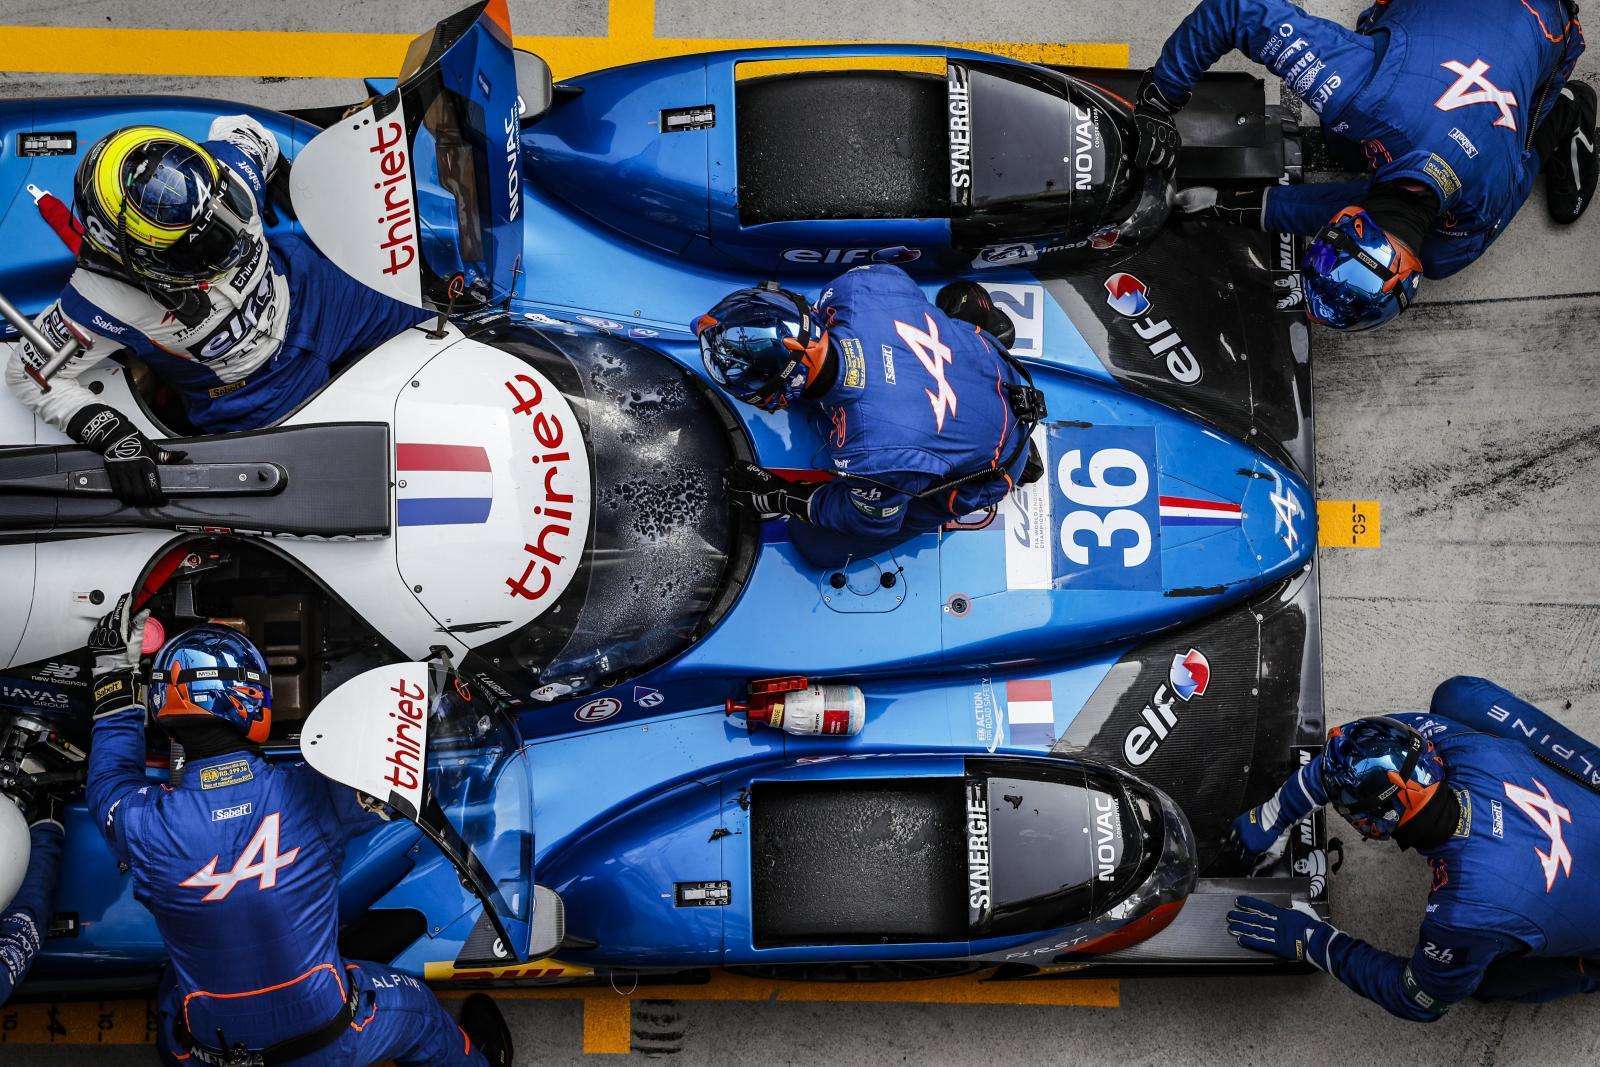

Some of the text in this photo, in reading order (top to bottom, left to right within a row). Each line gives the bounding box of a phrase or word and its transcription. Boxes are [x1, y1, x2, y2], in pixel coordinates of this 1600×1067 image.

[1318, 75, 1342, 104] elf
[949, 81, 971, 188] SYNERGIE
[1075, 107, 1093, 190] NOVAC
[188, 181, 228, 243] ALPINE
[370, 121, 415, 275] thiriet
[783, 249, 869, 263] elf
[92, 315, 128, 335] Sabelt
[1132, 316, 1202, 385] elf
[504, 373, 575, 601] thiriet
[1056, 447, 1153, 568] 36
[31, 674, 88, 687] new balance
[33, 700, 69, 709] GROUP
[96, 681, 121, 700] Sabelt
[974, 691, 986, 729] ACTION
[384, 678, 424, 790] thiriet
[983, 708, 993, 729] ROAD
[1123, 683, 1178, 768] elf
[216, 804, 251, 819] Sabelt
[1095, 797, 1115, 882] NOVAC
[968, 799, 990, 909] SYNERGIE
